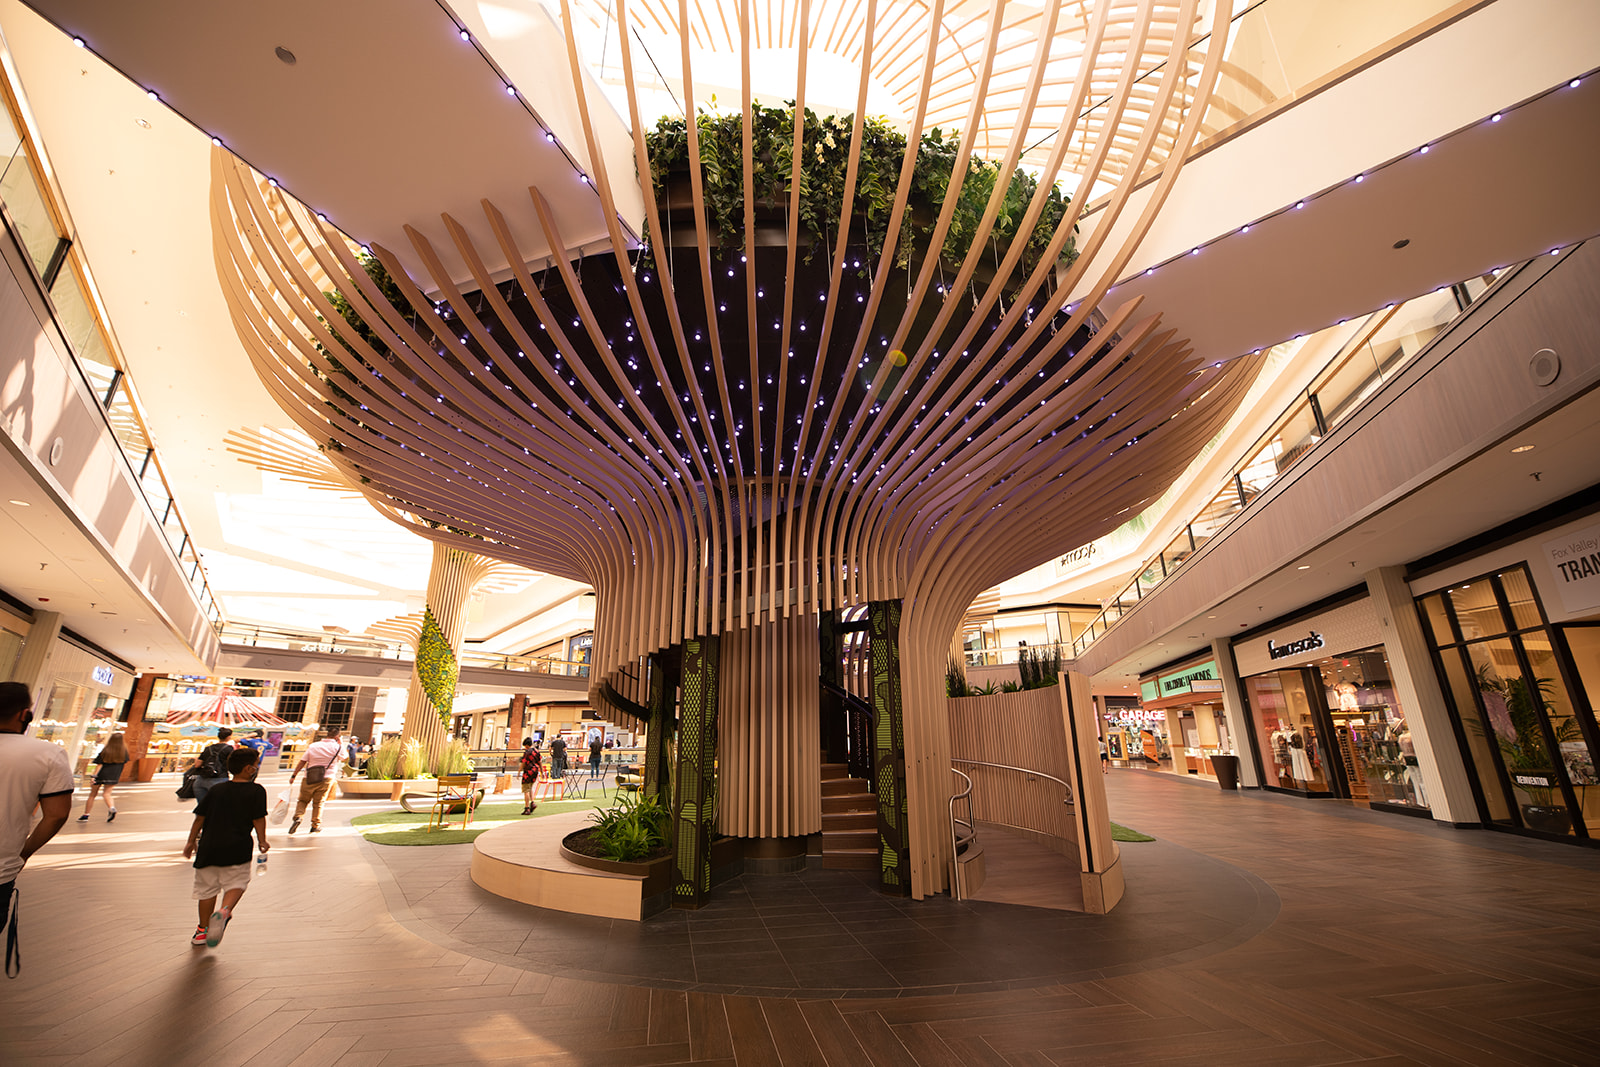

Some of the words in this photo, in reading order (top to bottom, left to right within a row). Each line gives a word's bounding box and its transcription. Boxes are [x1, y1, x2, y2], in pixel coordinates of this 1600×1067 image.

[1551, 548, 1568, 559] Fox
[1568, 538, 1598, 553] Valley
[1119, 710, 1165, 721] GARAGE
